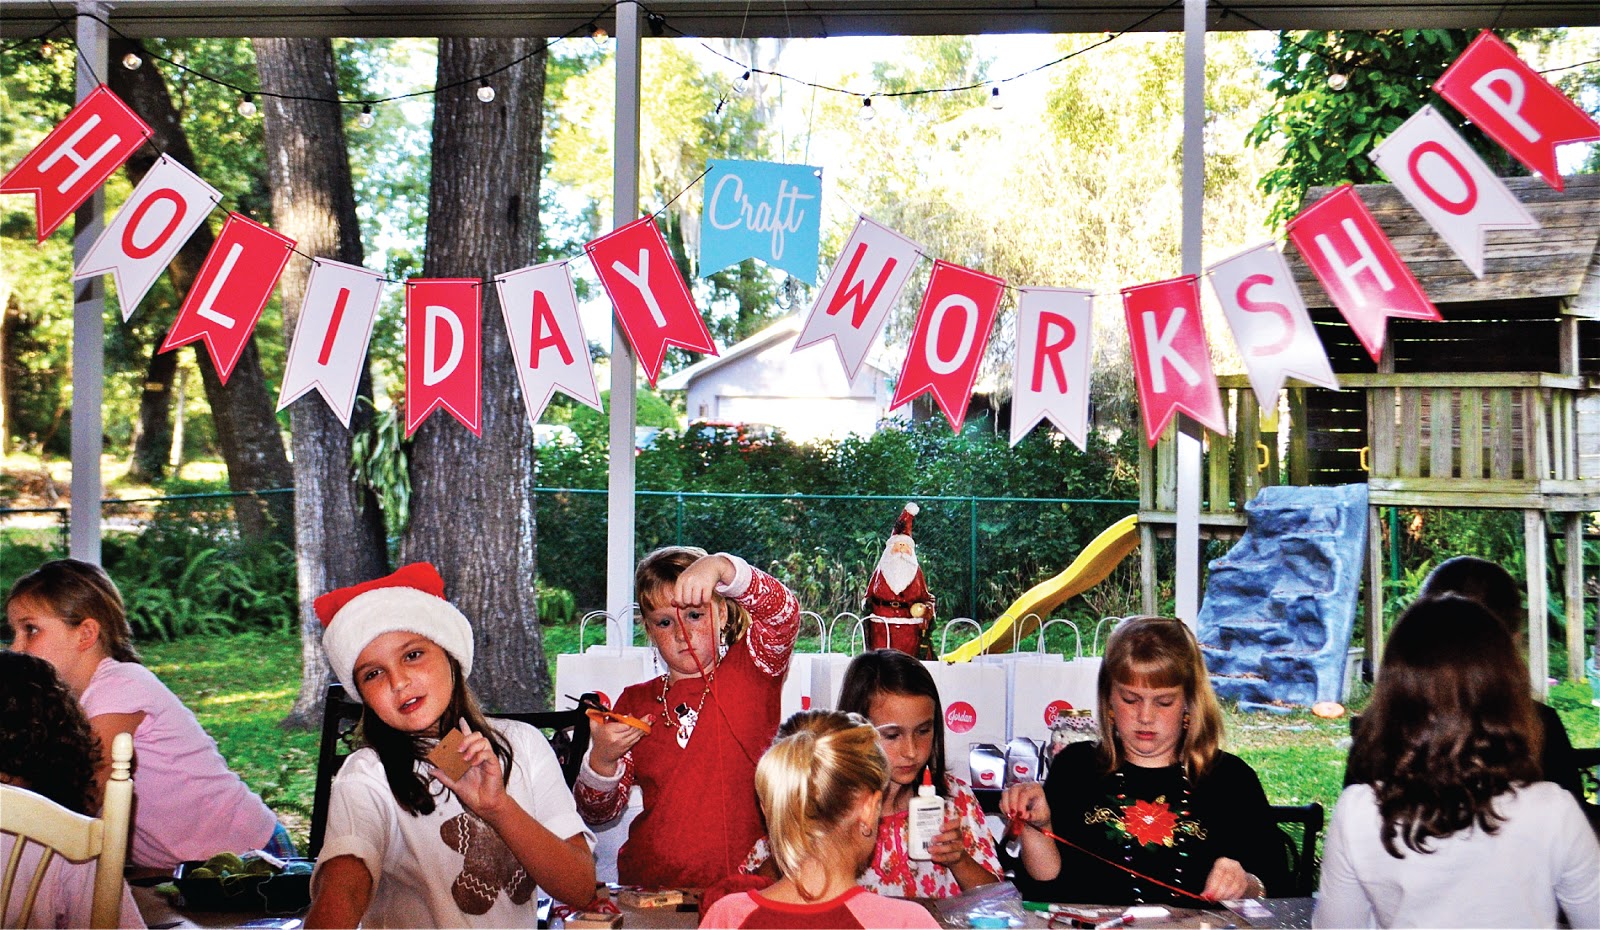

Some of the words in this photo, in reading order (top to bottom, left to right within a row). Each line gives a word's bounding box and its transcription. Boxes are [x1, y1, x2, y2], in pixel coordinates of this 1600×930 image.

[37, 113, 668, 387] HOLIDAY
[709, 173, 816, 260] Craft
[825, 67, 1543, 397] WORKSHOP
[947, 708, 973, 726] Jordan
